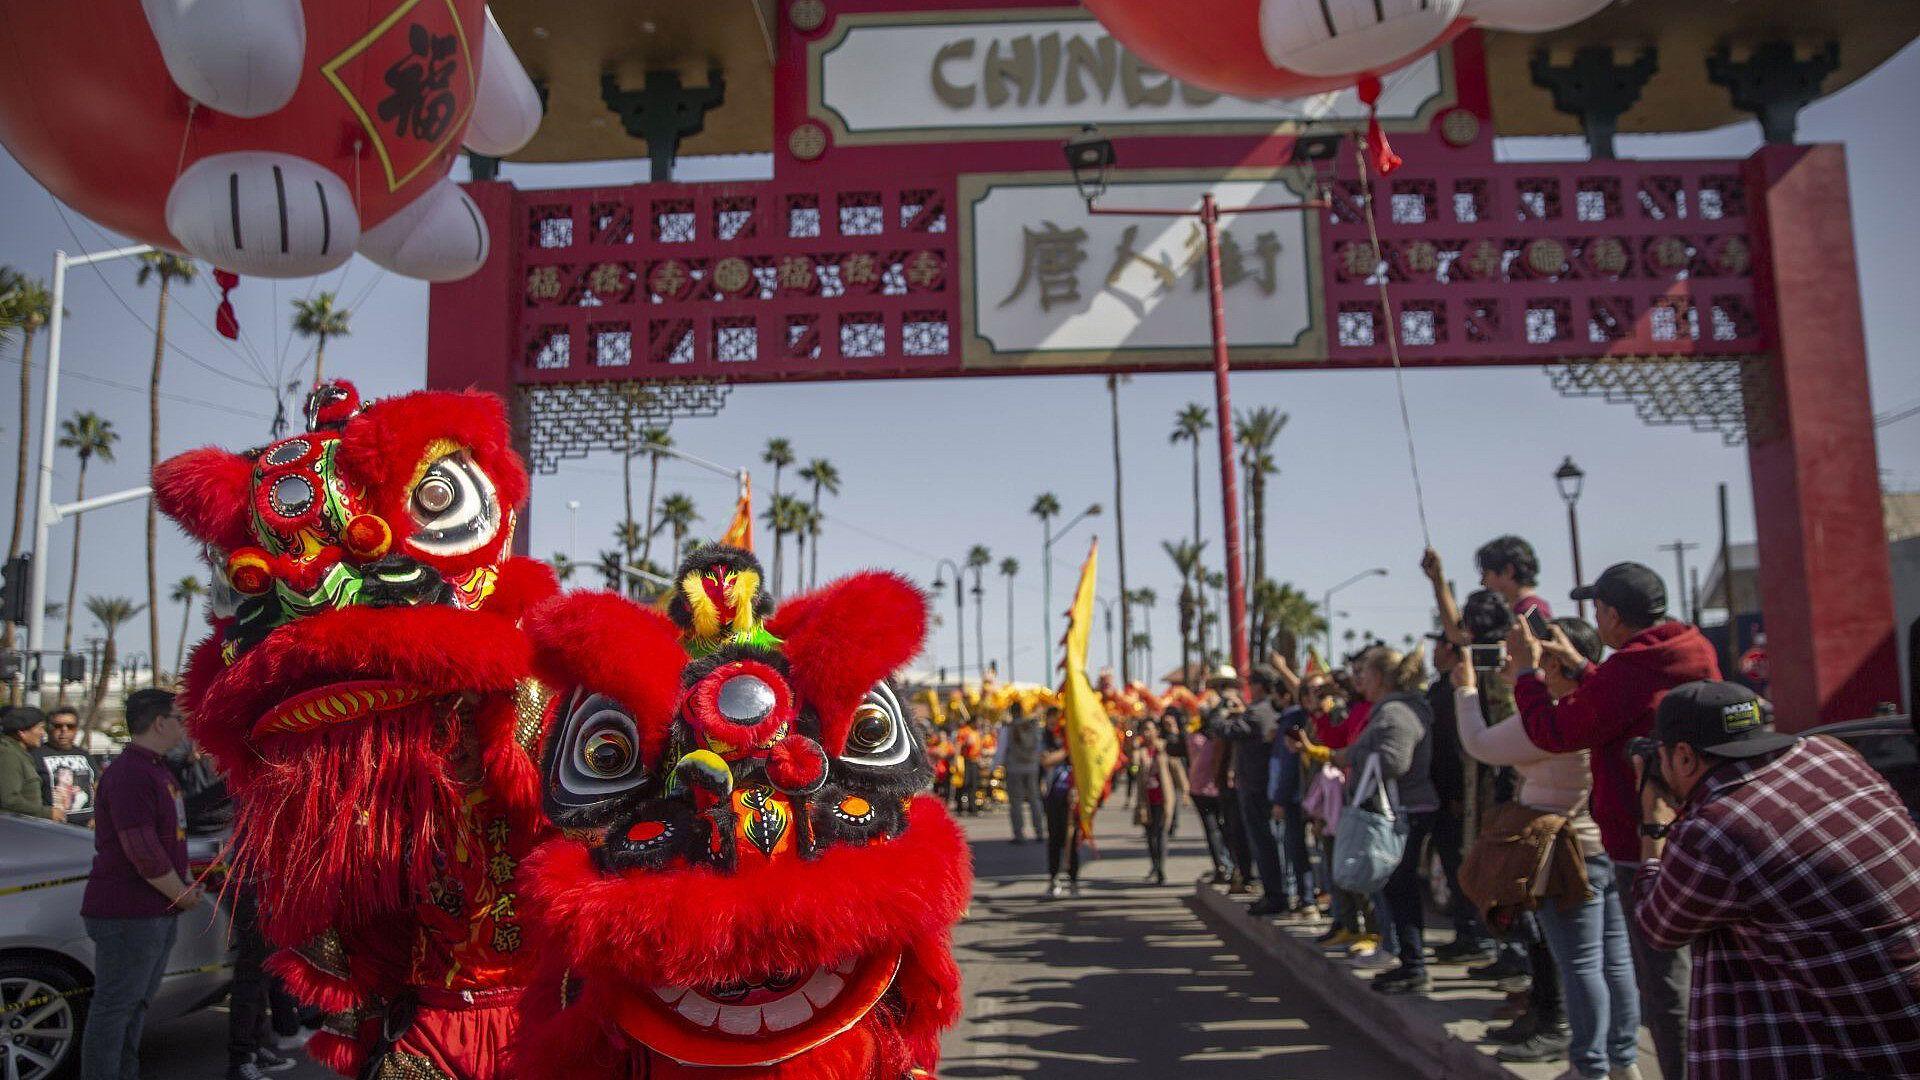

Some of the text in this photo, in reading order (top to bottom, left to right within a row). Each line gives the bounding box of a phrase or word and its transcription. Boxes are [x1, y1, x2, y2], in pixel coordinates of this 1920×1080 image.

[932, 28, 1222, 110] CHINE
[999, 221, 1283, 312] 唐人街
